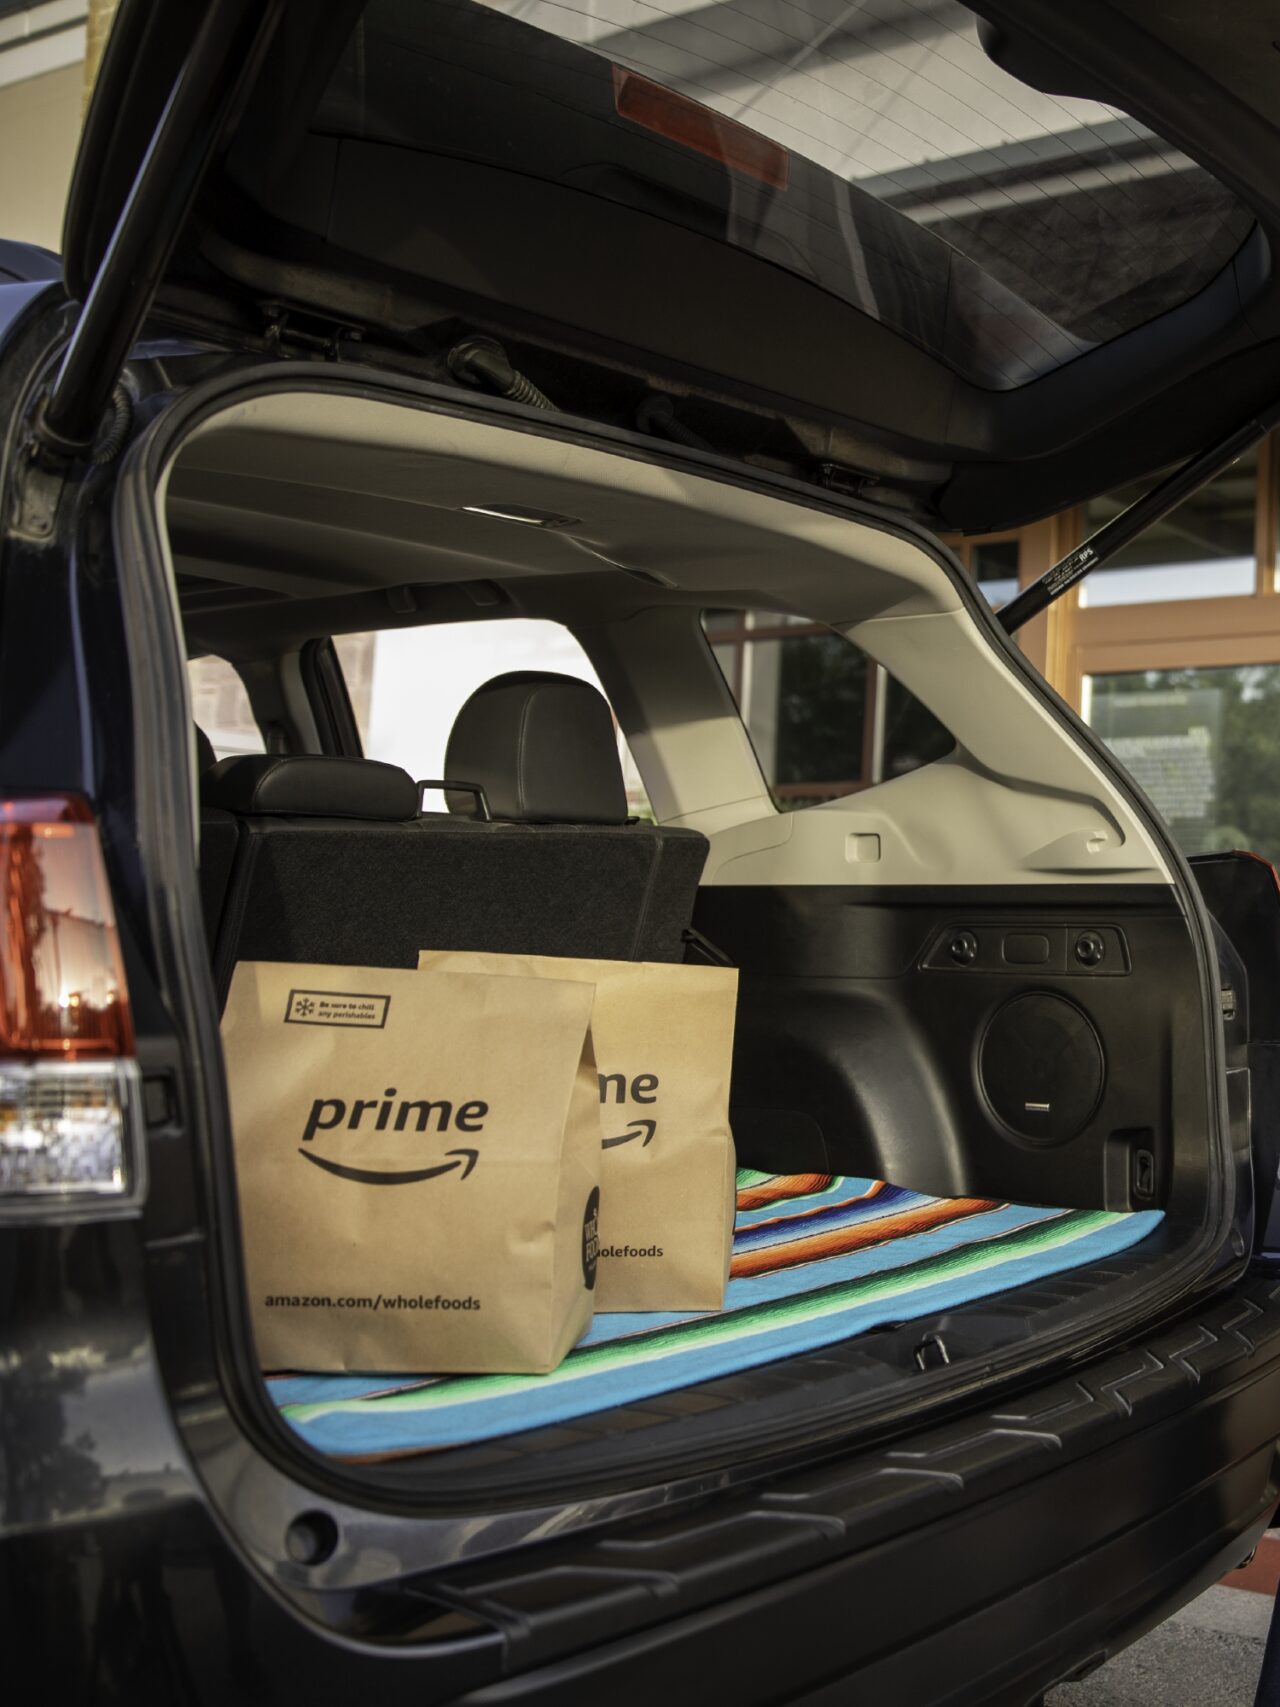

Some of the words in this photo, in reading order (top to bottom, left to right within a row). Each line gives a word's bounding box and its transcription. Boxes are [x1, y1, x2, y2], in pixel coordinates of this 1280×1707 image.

[318, 1011, 332, 1019] any
[333, 1011, 376, 1020] perishables
[302, 1087, 489, 1141] prime
[598, 1245, 664, 1258] olefoods
[264, 1293, 481, 1312] amazon.com/wholefoods
